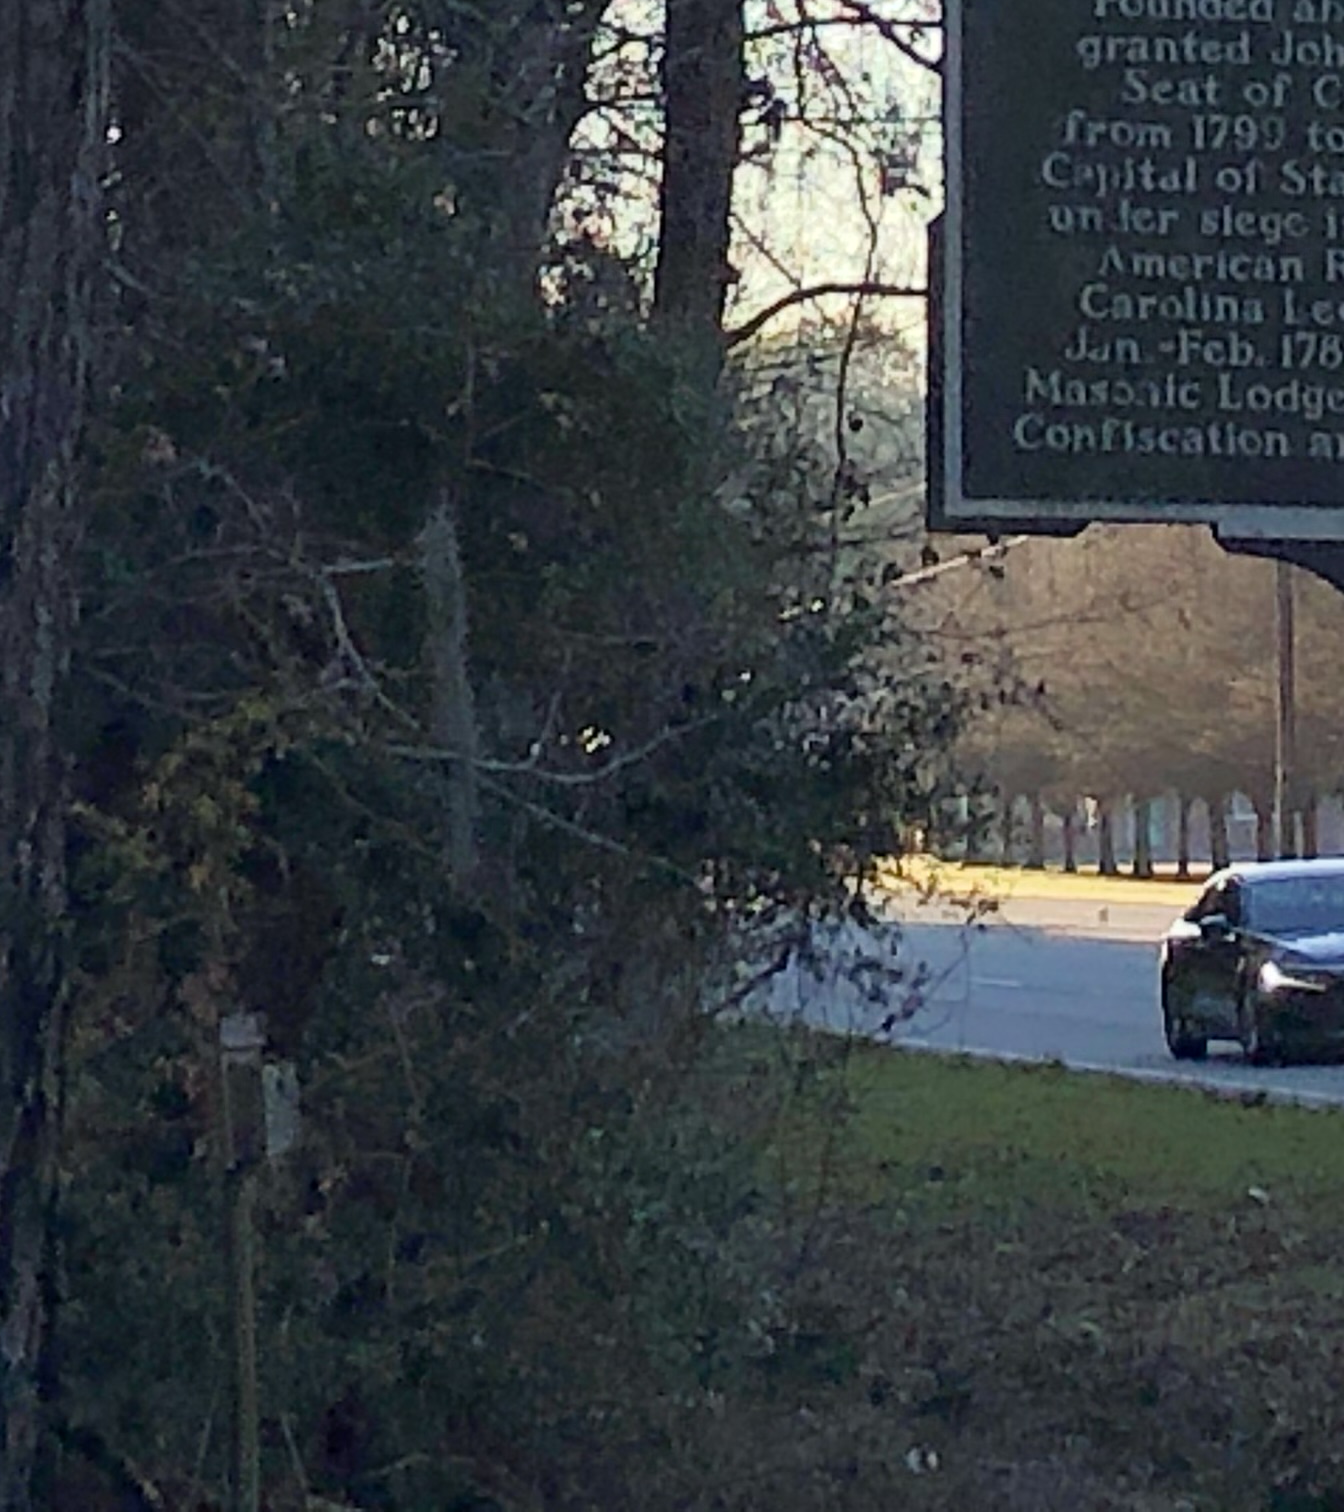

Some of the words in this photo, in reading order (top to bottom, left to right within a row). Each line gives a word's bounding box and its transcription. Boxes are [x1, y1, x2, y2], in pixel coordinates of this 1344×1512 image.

[1076, 30, 1251, 69] granted
[1122, 69, 1219, 106] Seat
[1243, 74, 1292, 108] of
[1062, 109, 1172, 148] from
[1193, 113, 1286, 152] 1799
[1041, 151, 1197, 197] Capital
[1215, 160, 1262, 194] of
[1199, 204, 1310, 243] siege
[1098, 245, 1304, 282] American
[1079, 283, 1264, 325] Carolina
[1013, 412, 1290, 457] Confiscation
